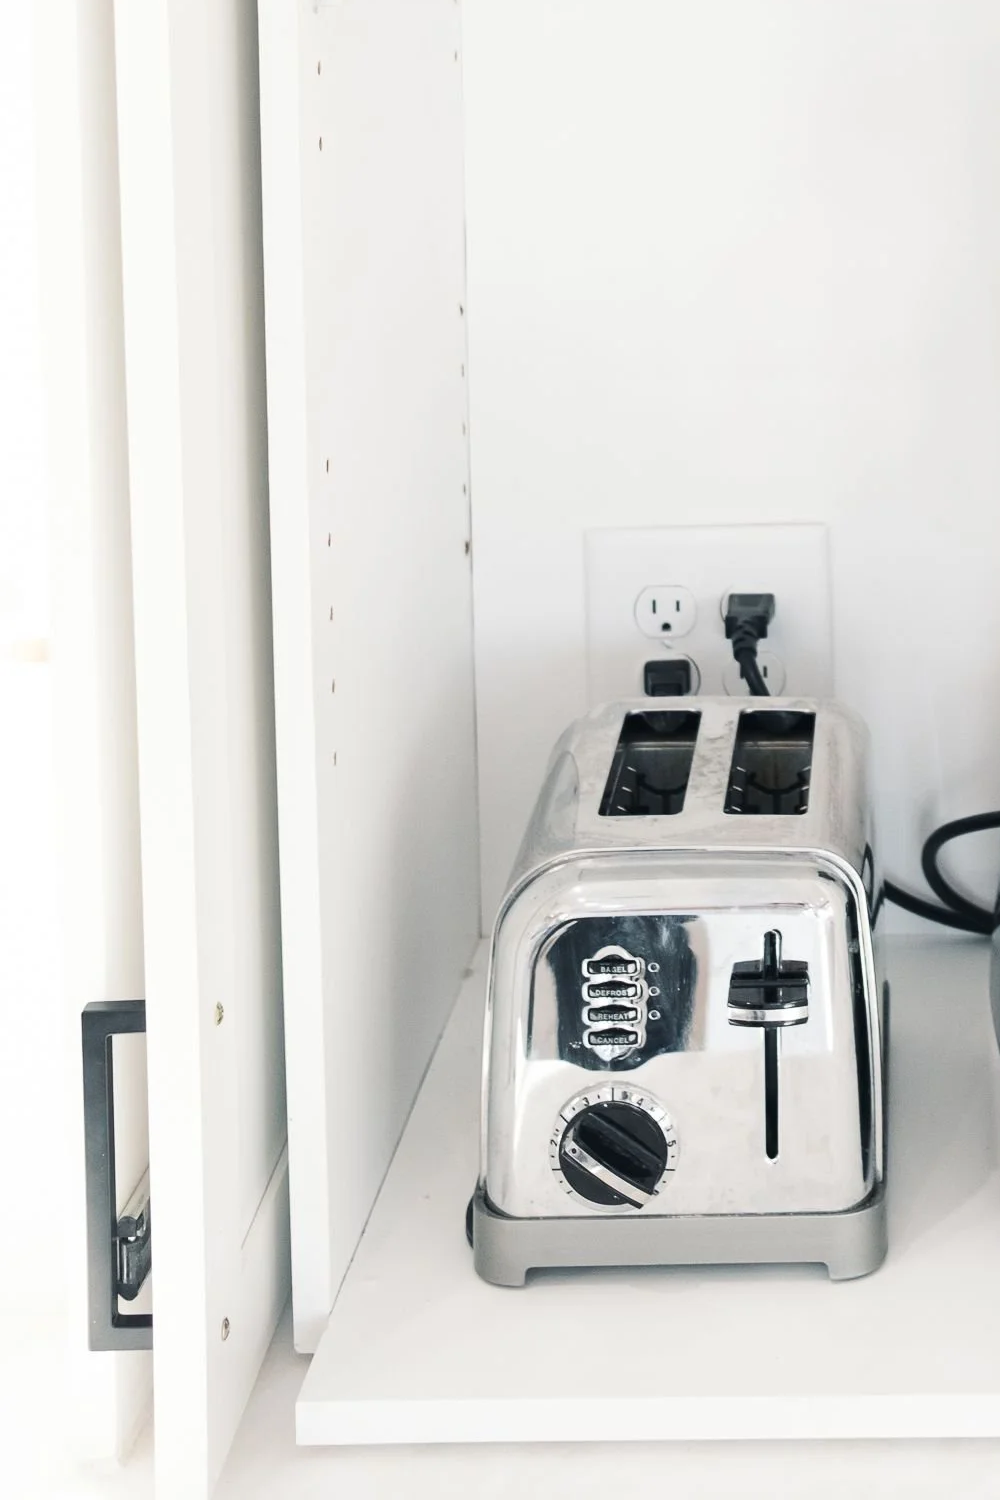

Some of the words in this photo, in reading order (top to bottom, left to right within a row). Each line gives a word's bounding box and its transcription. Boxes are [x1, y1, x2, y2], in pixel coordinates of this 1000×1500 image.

[582, 1096, 590, 1106] 3
[636, 1098, 644, 1107] 4
[550, 1139, 558, 1148] 2
[667, 1139, 676, 1148] 5
